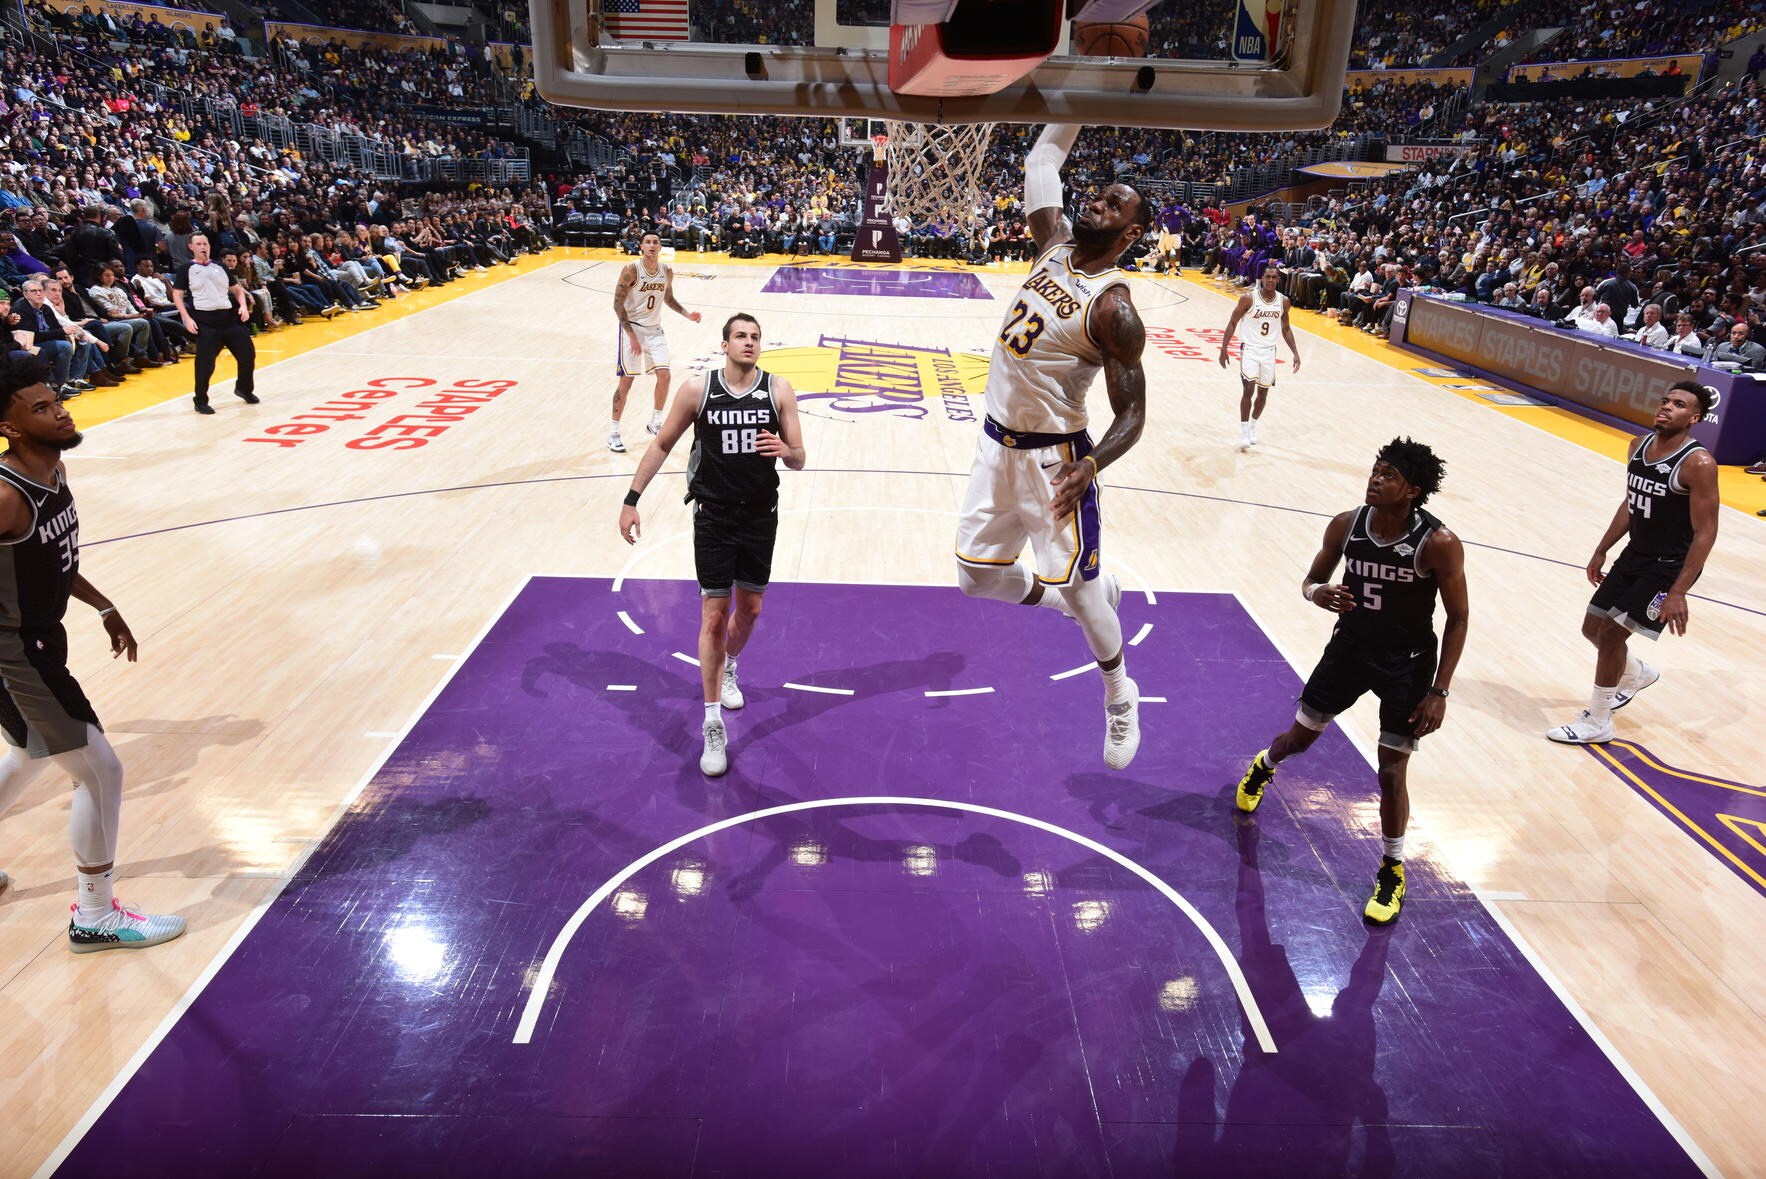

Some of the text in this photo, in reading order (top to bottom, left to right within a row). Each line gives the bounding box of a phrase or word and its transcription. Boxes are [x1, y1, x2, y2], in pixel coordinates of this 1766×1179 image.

[1239, 36, 1260, 54] NBA
[638, 281, 665, 292] LAKERS
[1022, 267, 1081, 319] LAKERS
[1075, 279, 1092, 297] wish
[647, 295, 655, 309] 0
[1253, 309, 1281, 319] LAKERS
[998, 300, 1044, 358] 23
[1261, 321, 1270, 336] 9
[1413, 310, 1475, 353] STAPLES
[1484, 331, 1564, 383] STAPLES
[242, 377, 438, 448] Center
[345, 379, 518, 450] STAPLES
[707, 409, 770, 425] KINGS
[721, 428, 757, 454] 88
[1627, 490, 1652, 519] 24
[38, 500, 78, 545] KING
[1346, 558, 1415, 583] KINGS
[1363, 582, 1383, 611] 5
